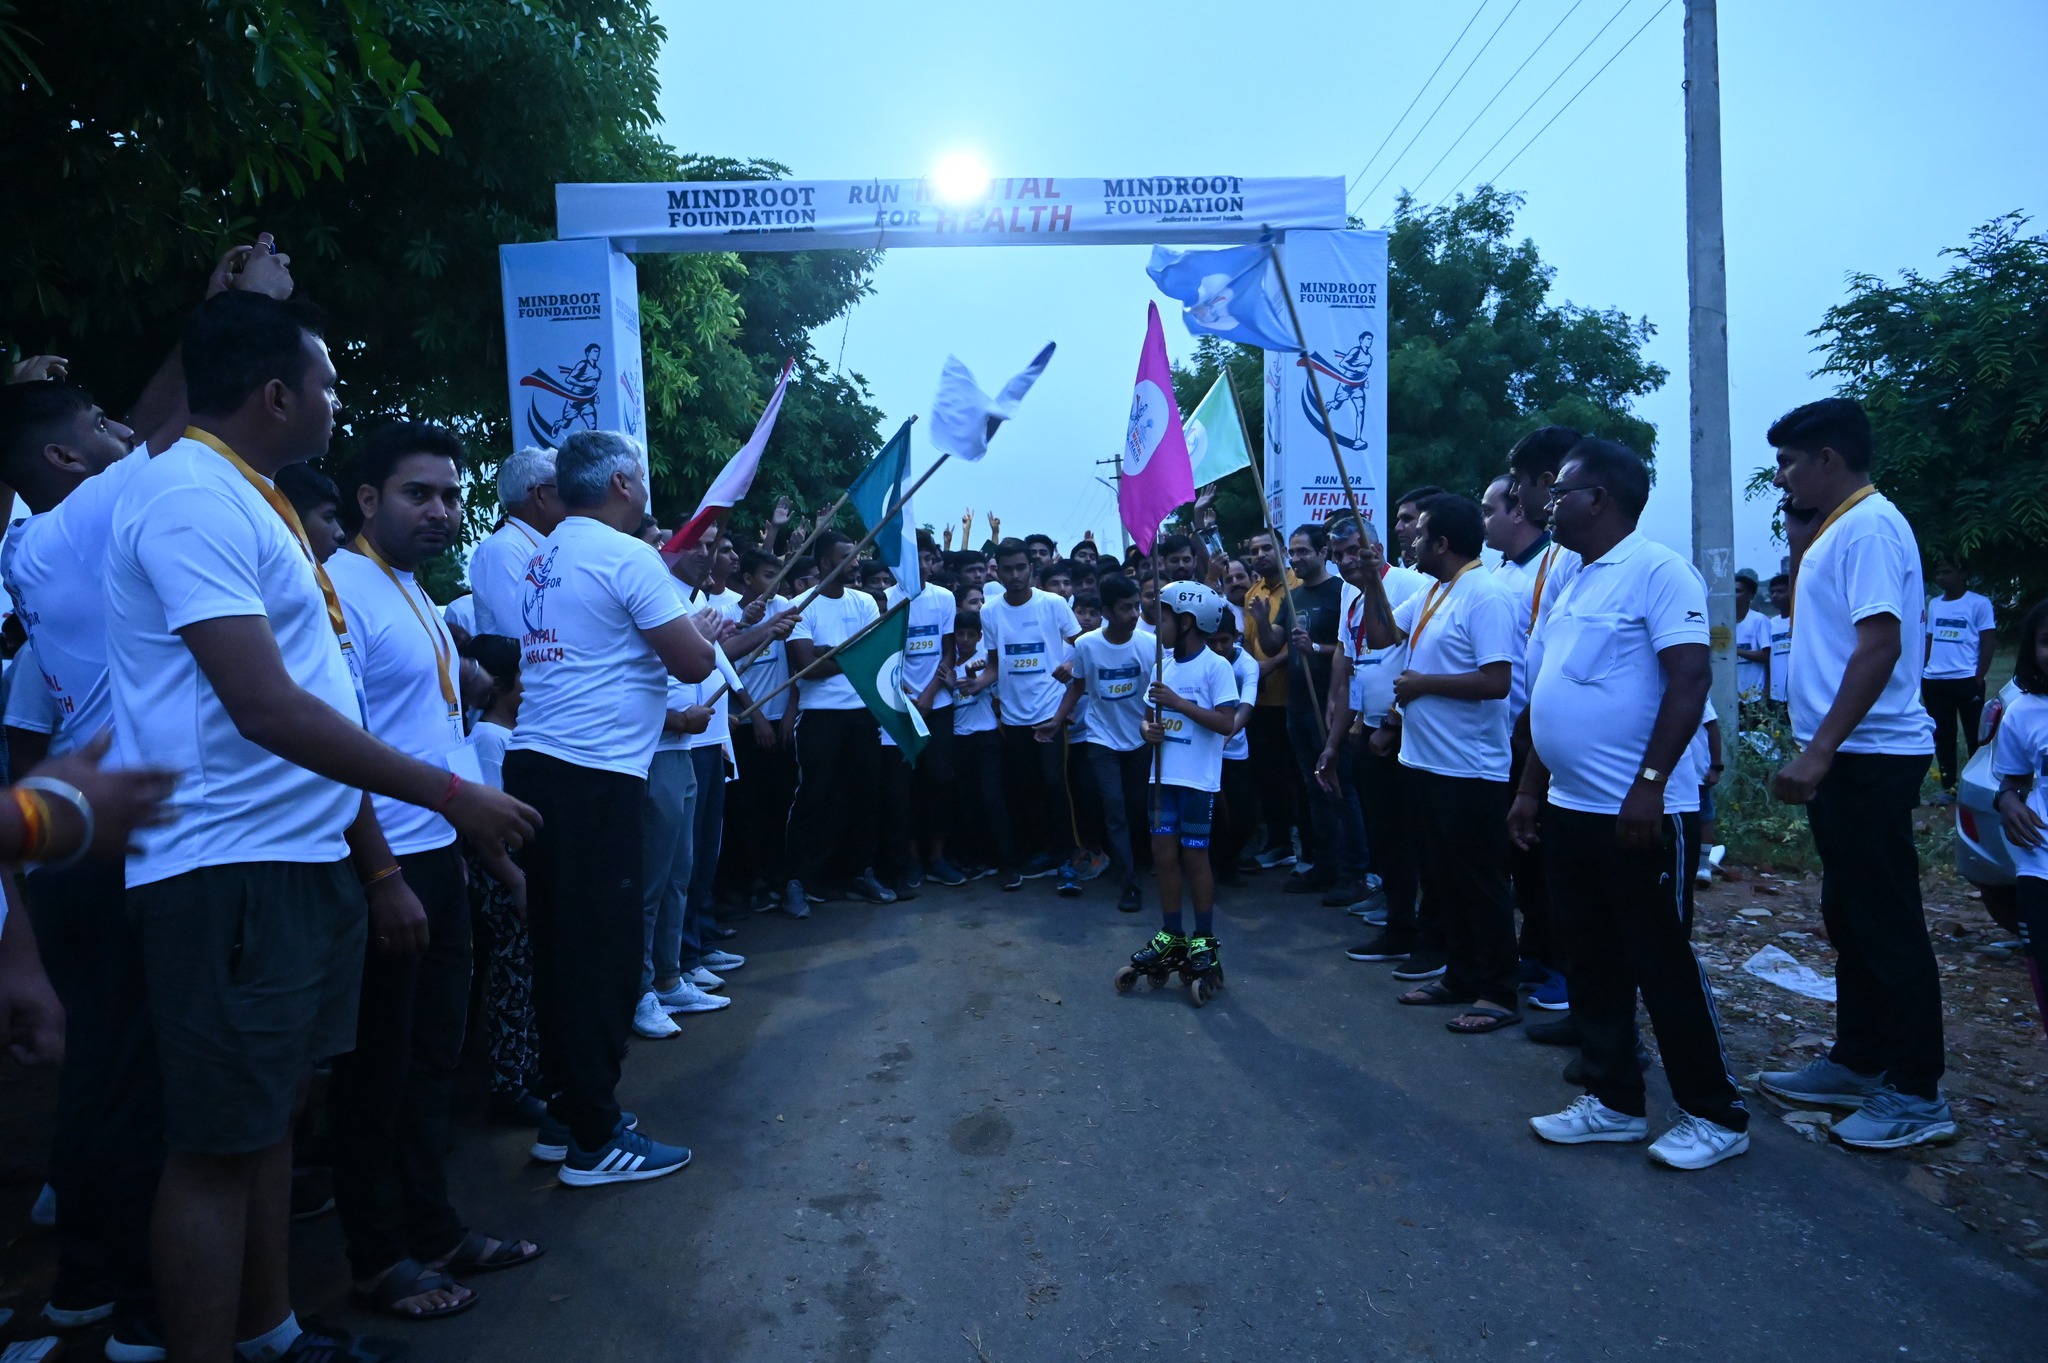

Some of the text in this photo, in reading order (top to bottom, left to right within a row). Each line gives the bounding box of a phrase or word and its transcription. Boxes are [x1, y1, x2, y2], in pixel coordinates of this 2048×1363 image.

[1103, 176, 1244, 198] MINDROOT
[666, 187, 816, 209] MINDROOT
[848, 185, 900, 204] RUN
[1104, 196, 1244, 215] FOUNDATION
[668, 208, 817, 228] FOUNDATION
[874, 204, 1073, 234] FOR HEALTH
[1299, 282, 1377, 294] MINDROOT
[518, 292, 600, 307] MINDROOT
[1300, 293, 1377, 304] FOUNDATION
[518, 304, 601, 318] FOUNDATION
[1314, 476, 1338, 485] RUN
[1178, 591, 1203, 603] 671
[909, 640, 934, 651] 2299
[525, 647, 564, 665] HEALTH
[1013, 658, 1039, 668] 2298
[1108, 682, 1133, 694] 1660
